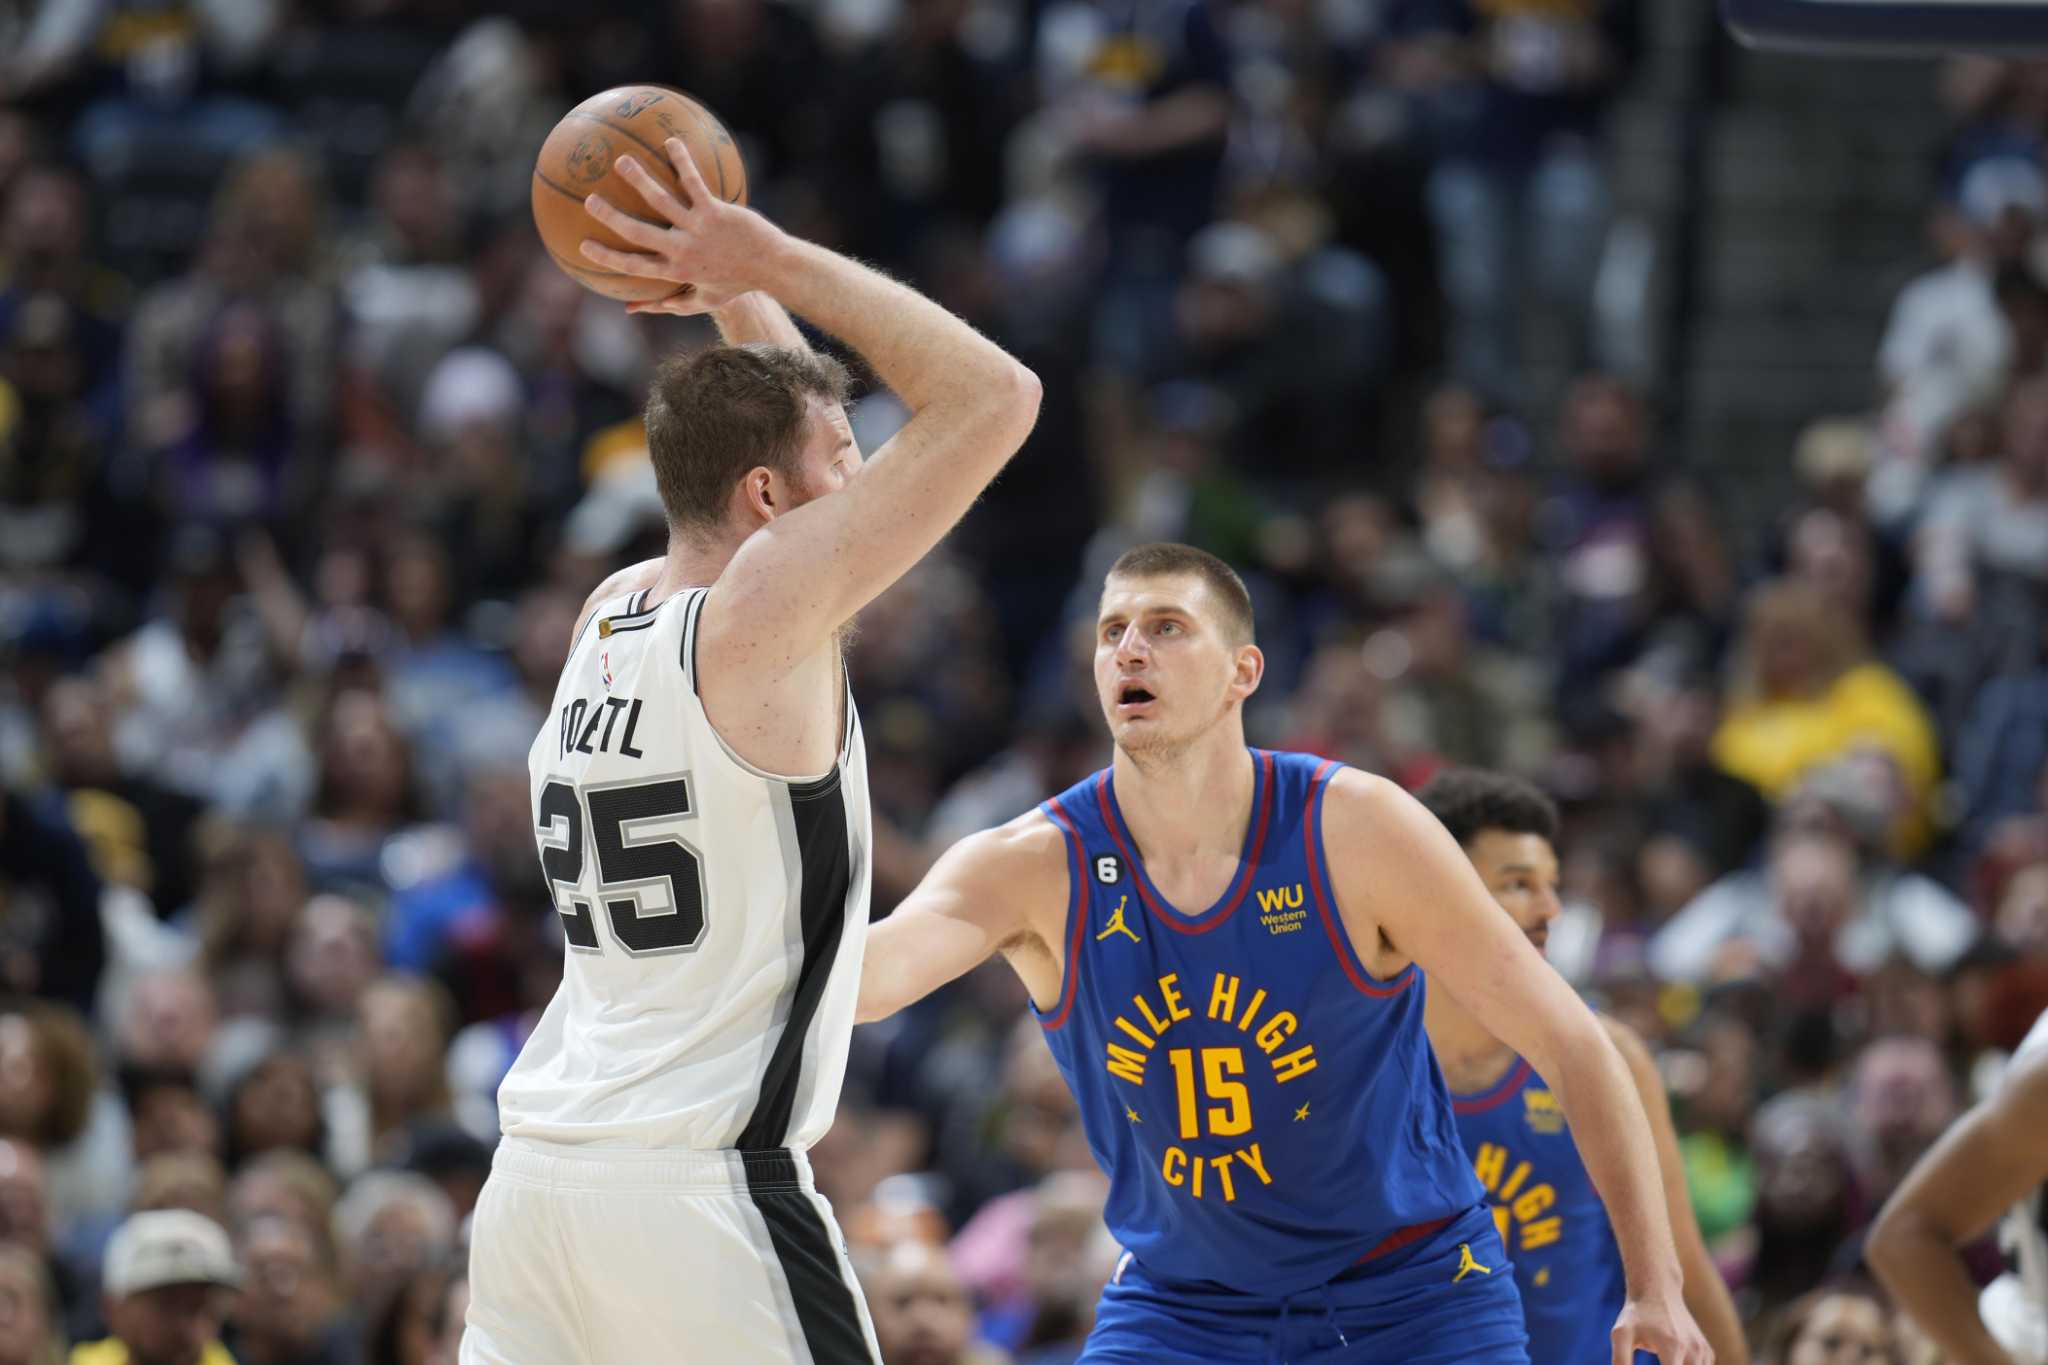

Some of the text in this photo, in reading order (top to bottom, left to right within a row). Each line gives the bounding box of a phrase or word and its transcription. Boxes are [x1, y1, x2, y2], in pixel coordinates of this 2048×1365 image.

[537, 772, 708, 957] 25
[1097, 857, 1118, 883] 6
[1256, 884, 1304, 912] WU
[1260, 910, 1307, 926] Western
[1270, 922, 1302, 935] Union
[1106, 973, 1318, 1085] MILE HIGH
[1169, 1047, 1252, 1139] 15
[1162, 1143, 1272, 1202] CITY
[1475, 1142, 1562, 1250] HIGH
